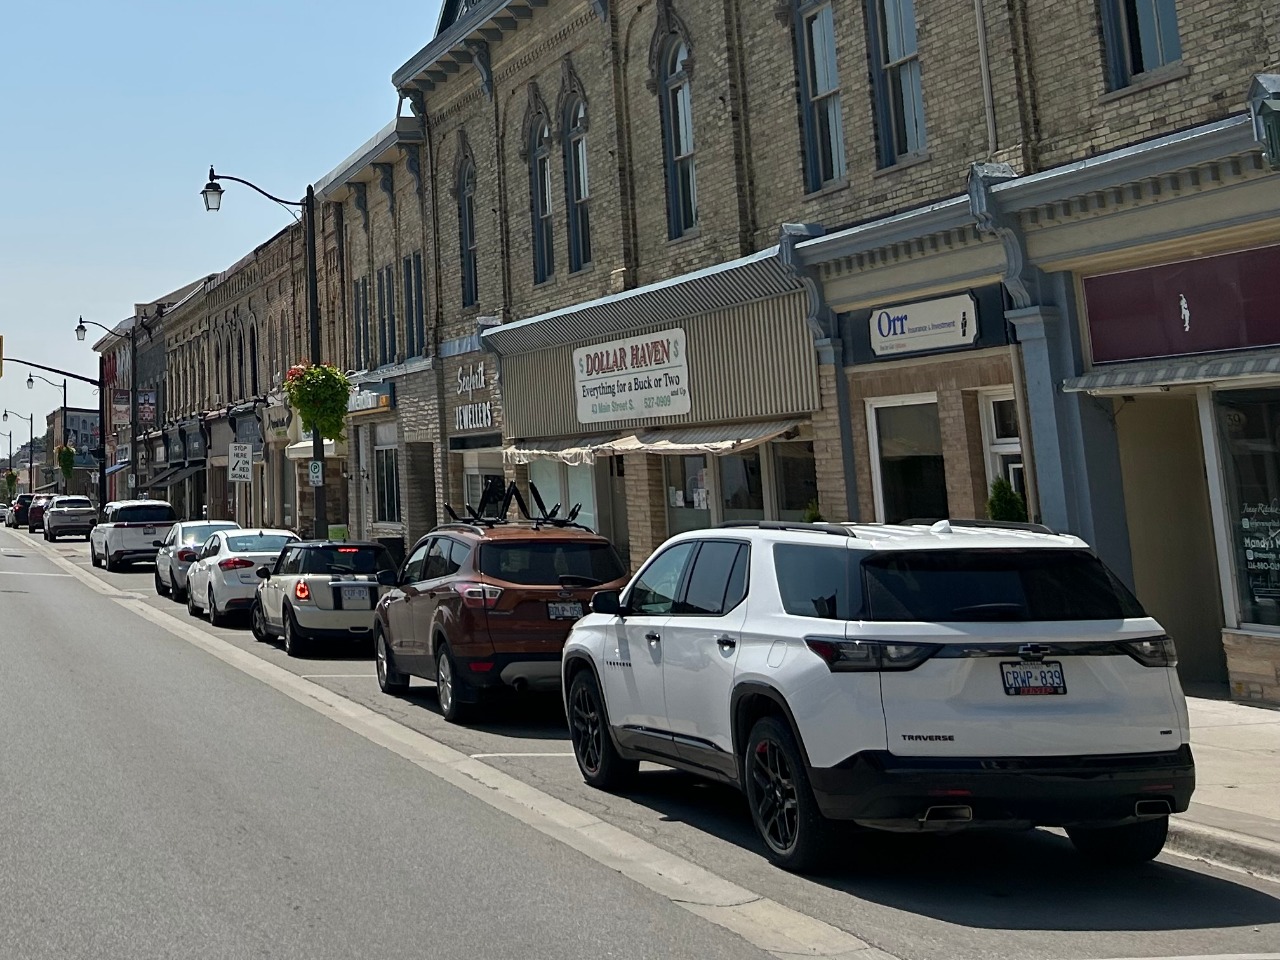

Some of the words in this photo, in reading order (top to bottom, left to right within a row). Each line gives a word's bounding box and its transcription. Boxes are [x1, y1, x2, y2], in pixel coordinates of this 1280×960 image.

[877, 311, 908, 337] Orr
[585, 347, 628, 376] DOLLAR
[630, 338, 671, 369] HAVEN
[457, 361, 486, 401] Seaforth
[581, 381, 616, 399] Everything
[616, 380, 626, 393] for
[627, 383, 632, 392] a
[633, 376, 652, 391] Buck
[654, 378, 662, 388] or
[663, 373, 680, 387] Two
[670, 388, 679, 396] and
[679, 387, 687, 397] Up
[455, 401, 492, 430] JEWELLERS
[598, 403, 610, 414] Main
[611, 401, 628, 412] Street
[1244, 536, 1274, 551] Mandy's
[1005, 670, 1033, 688] CRWP
[1039, 670, 1062, 686] 839
